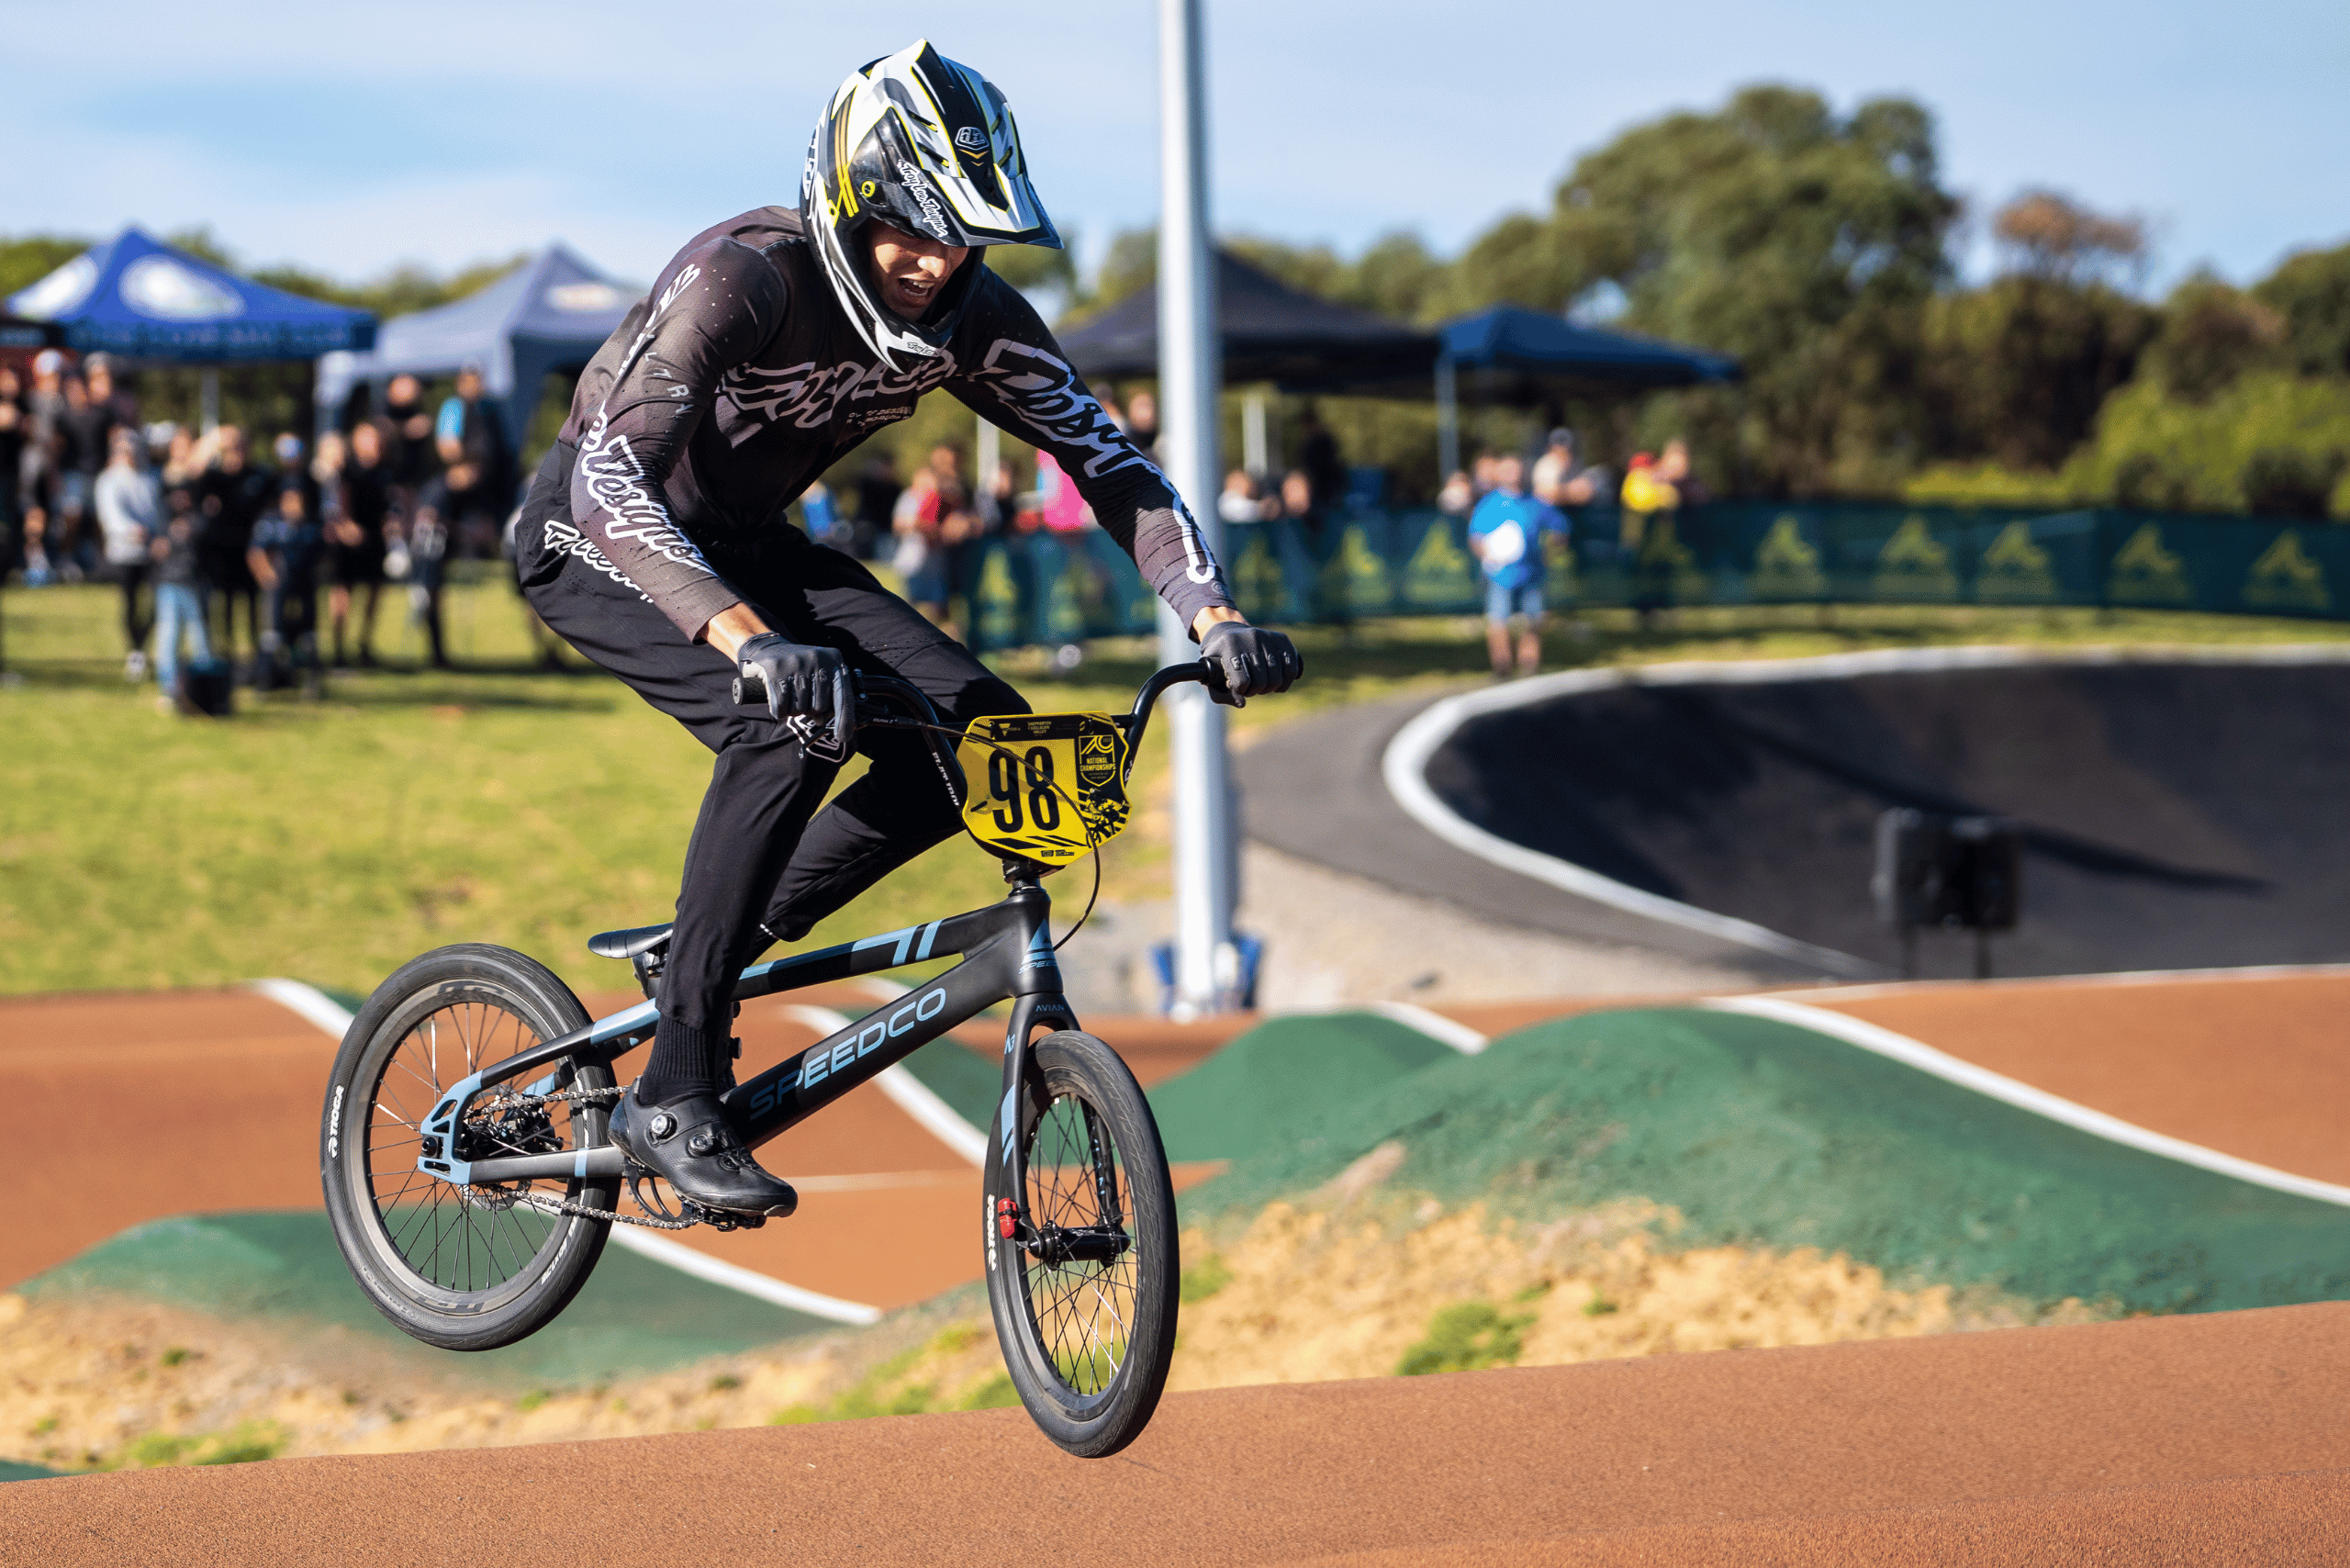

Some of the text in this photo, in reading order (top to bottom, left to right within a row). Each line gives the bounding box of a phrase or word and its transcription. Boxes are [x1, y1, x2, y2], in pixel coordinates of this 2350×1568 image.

[989, 745, 1060, 834] 98
[1035, 1004, 1065, 1013] AVIAN
[749, 987, 946, 1121] SPEEDCO
[330, 1084, 345, 1137] TIOGA
